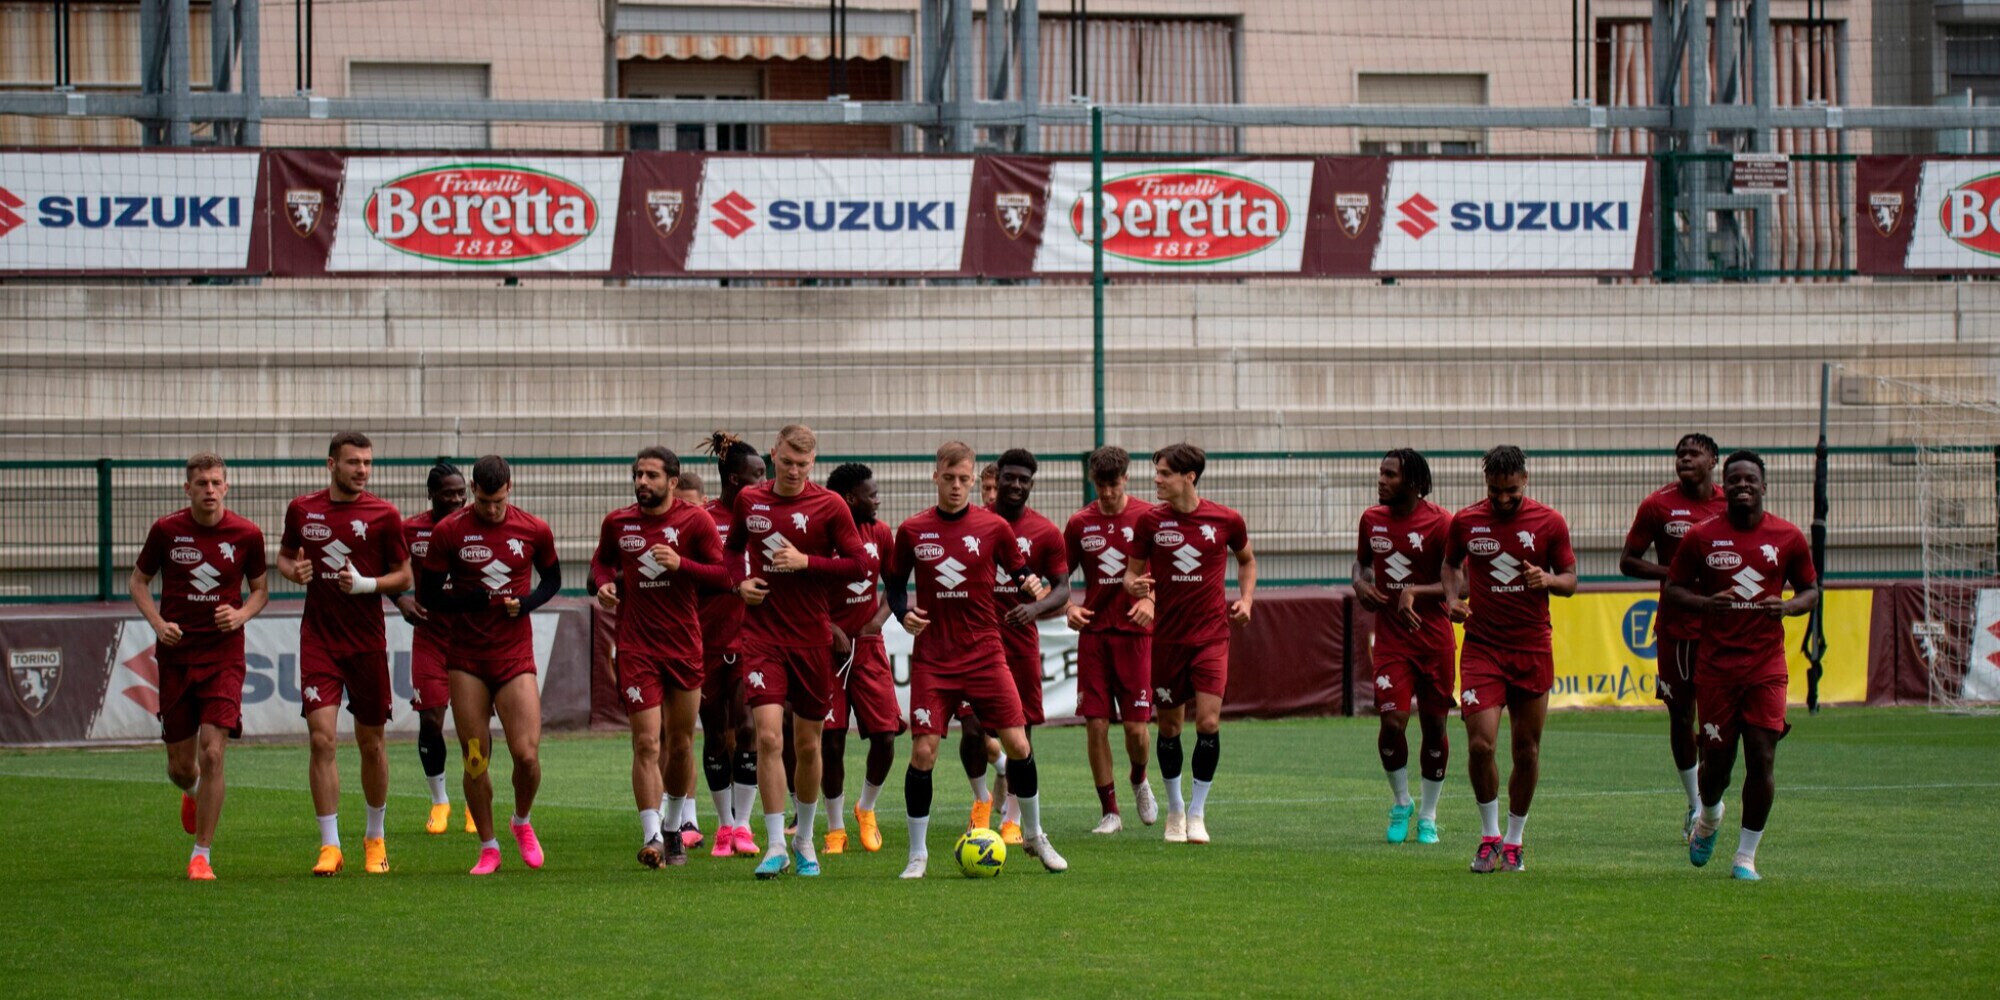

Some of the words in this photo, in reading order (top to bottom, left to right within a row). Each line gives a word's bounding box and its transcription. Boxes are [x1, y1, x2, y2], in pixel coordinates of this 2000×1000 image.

[435, 173, 523, 192] Fratelli
[1136, 179, 1219, 197] Fratelli
[38, 196, 240, 229] SUZUKI
[373, 187, 590, 239] Beretta
[768, 200, 955, 231] SUZUKI
[1078, 190, 1281, 241] Beretta
[1450, 202, 1628, 231] SUZUKI
[452, 240, 513, 255] 1812
[1151, 242, 1210, 256] 1812
[1108, 523, 1115, 534] 2
[171, 549, 201, 560] Beretta
[461, 547, 492, 558] Beretta
[1708, 554, 1740, 565] Beretta
[13, 653, 57, 664] TORINO
[41, 668, 57, 678] FC
[1140, 689, 1147, 700] 2
